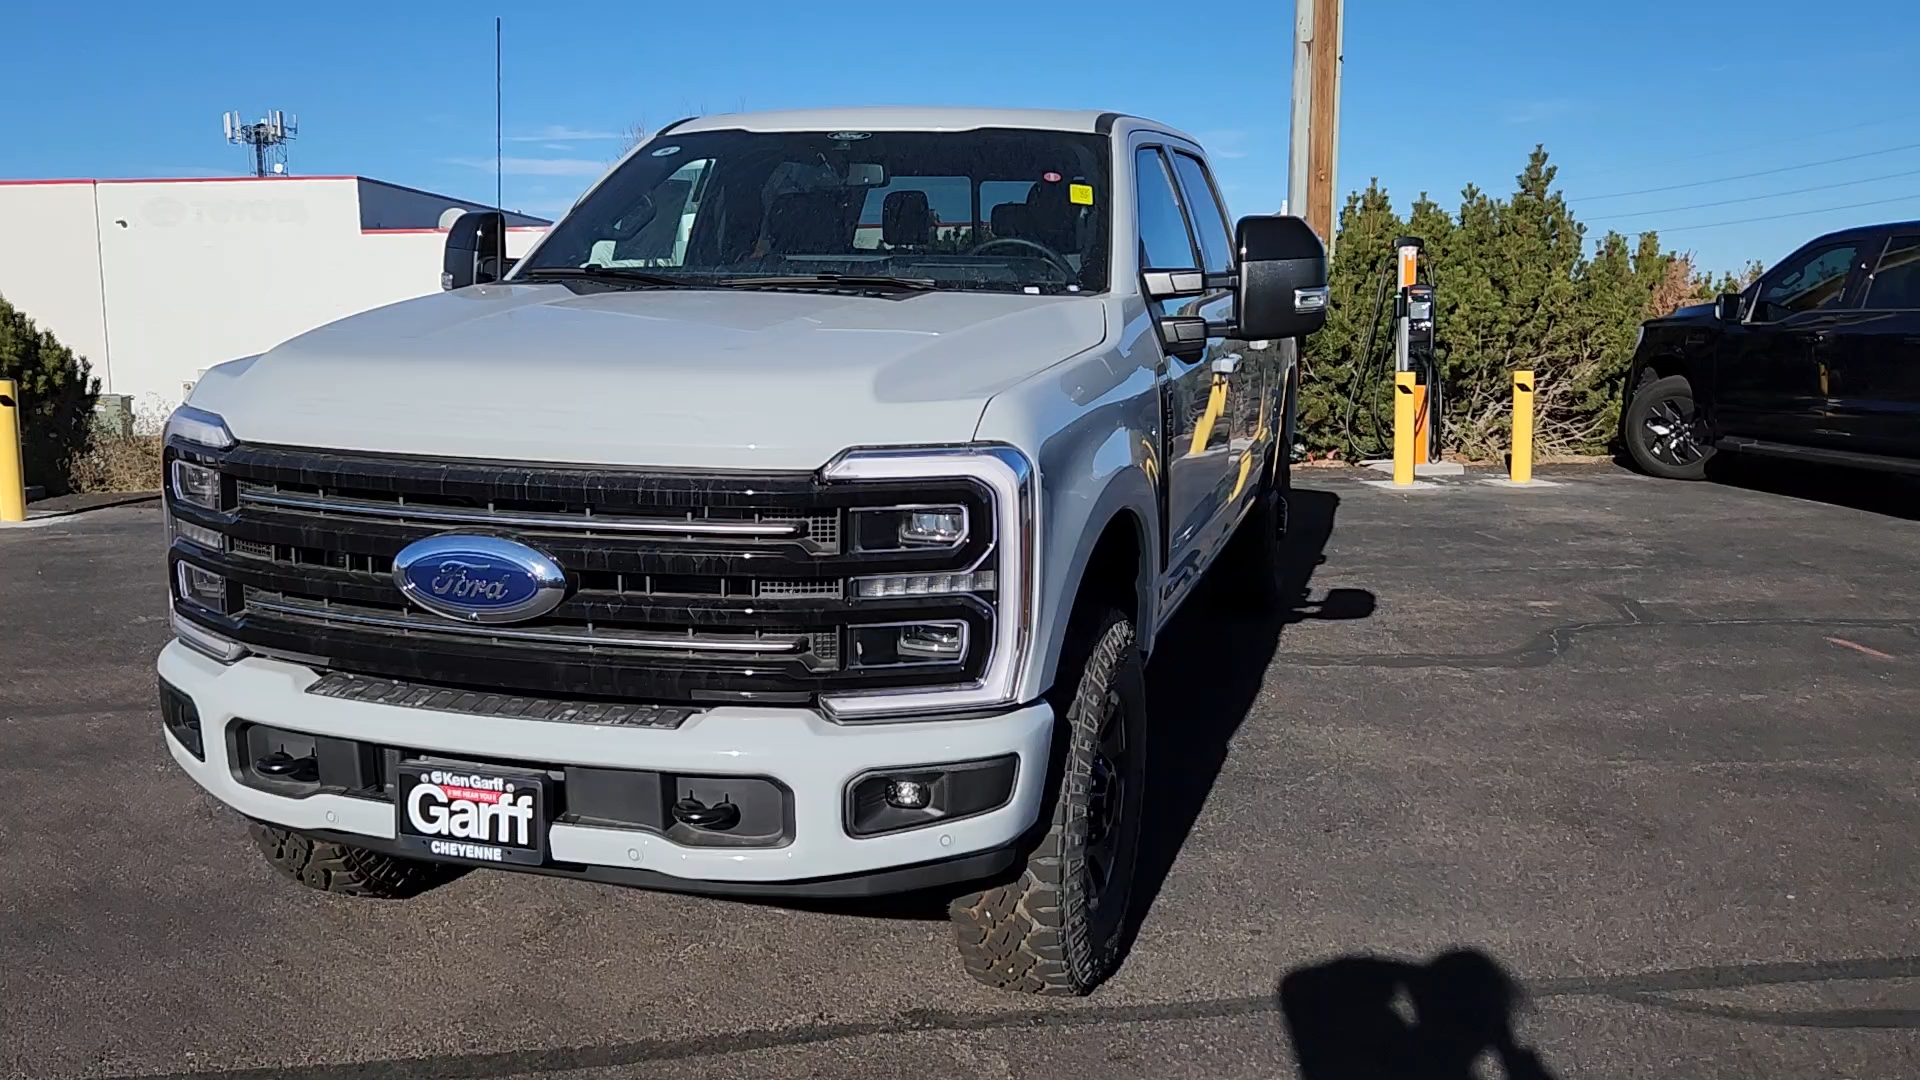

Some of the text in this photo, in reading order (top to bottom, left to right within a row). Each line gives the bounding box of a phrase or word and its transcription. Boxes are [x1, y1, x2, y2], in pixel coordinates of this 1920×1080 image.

[431, 560, 511, 600] Ford
[442, 771, 504, 792] Ken Garff
[407, 783, 533, 845] Garff
[431, 840, 502, 861] CHEYENNE
